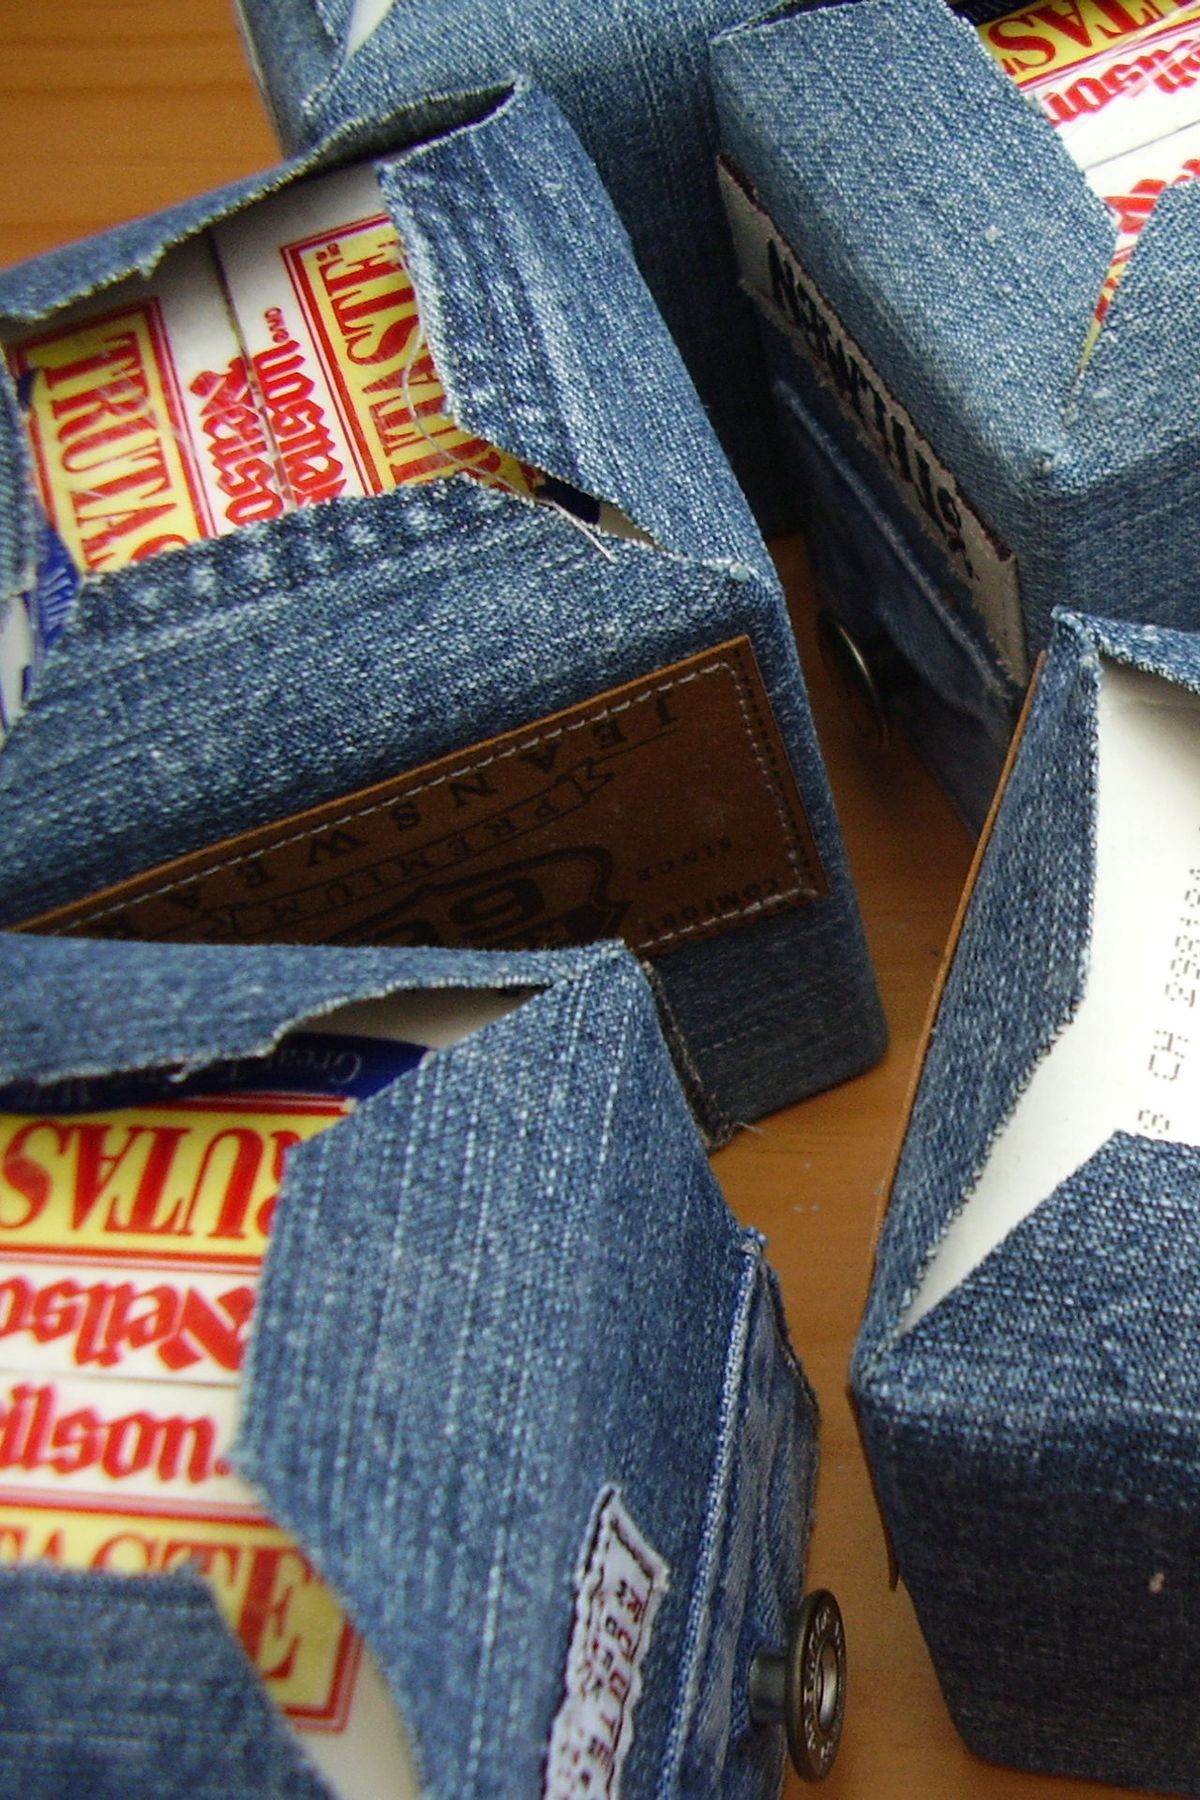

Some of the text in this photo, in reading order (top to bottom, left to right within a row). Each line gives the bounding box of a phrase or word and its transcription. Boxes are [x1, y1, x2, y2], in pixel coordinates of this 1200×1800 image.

[270, 797, 560, 925] PREMIUM
[636, 836, 732, 883] SINCE
[1148, 1029, 1190, 1082] CH
